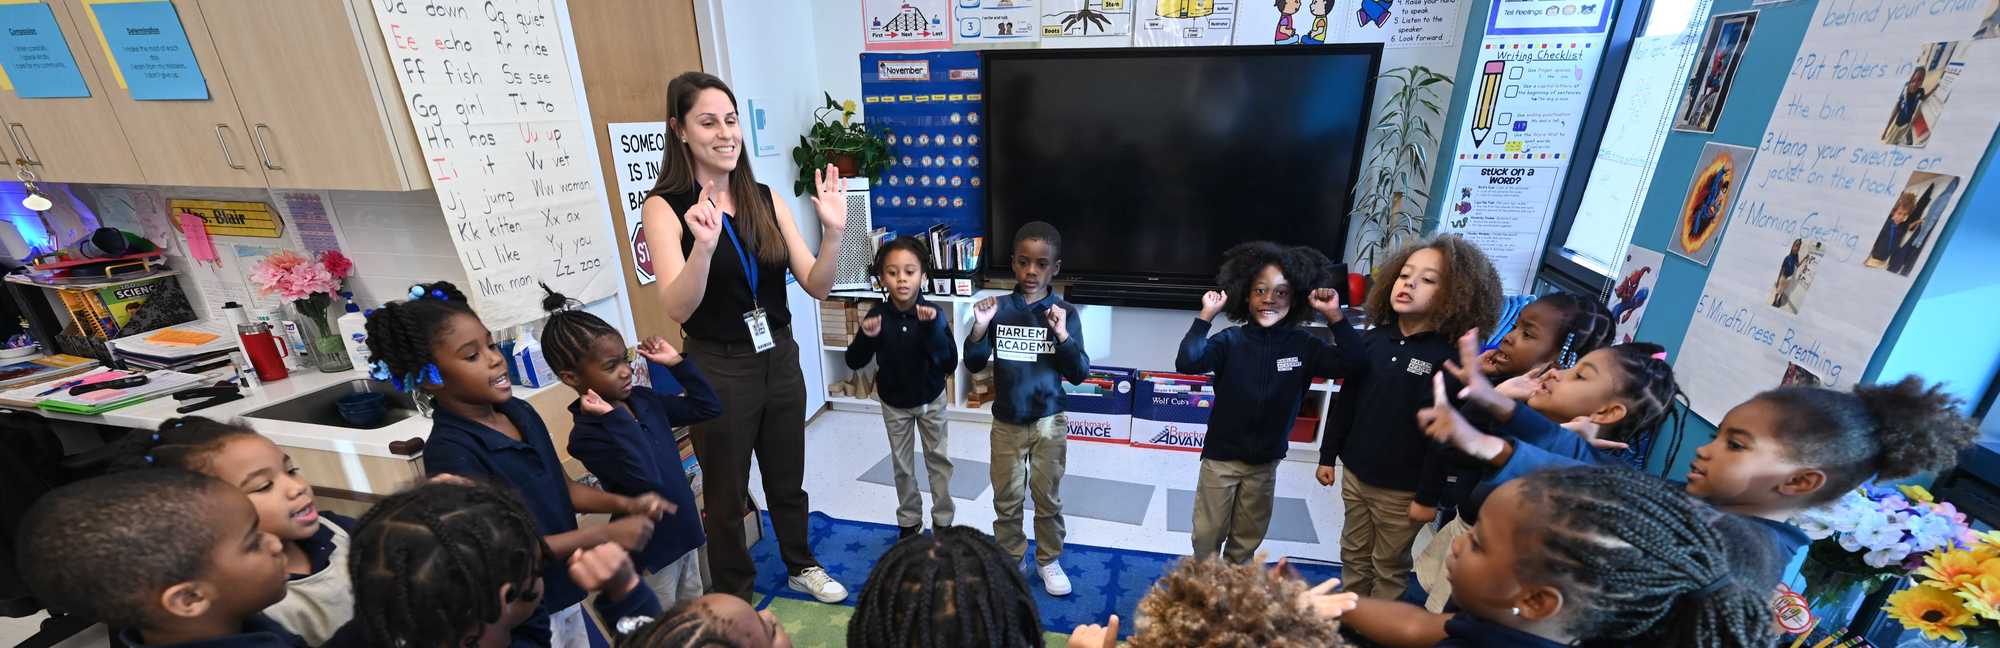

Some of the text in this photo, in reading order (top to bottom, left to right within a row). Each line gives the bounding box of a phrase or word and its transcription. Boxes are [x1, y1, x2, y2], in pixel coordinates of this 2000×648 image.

[517, 9, 545, 34] quiet
[968, 21, 974, 31] 3
[1401, 16, 1421, 24] Listen
[391, 24, 473, 51] Ee echo
[1416, 33, 1443, 41] forward
[1497, 49, 1583, 63] Writing Checklist
[1803, 53, 1826, 80] Put
[1833, 49, 1889, 80] folders
[403, 58, 483, 85] Ff fish
[502, 63, 551, 85] Ss see
[886, 66, 924, 75] November
[412, 93, 485, 127] Gg girl
[509, 92, 555, 114] Tt to
[1788, 93, 1810, 118] the
[424, 126, 455, 149] Hh
[519, 120, 562, 150] Uu up
[621, 133, 666, 154] SOMEO
[525, 149, 570, 170] Vv vet
[1773, 137, 1807, 162] Hang
[1811, 144, 1847, 169] your
[1916, 156, 1942, 170] or
[479, 154, 496, 176] it
[628, 161, 661, 182] IS IN
[1511, 168, 1525, 176] on
[1759, 162, 1805, 189] jacket
[1807, 170, 1824, 184] on
[1831, 167, 1855, 190] the
[532, 178, 555, 198] Ww
[1489, 177, 1522, 185] WORD?
[447, 187, 515, 220] Jj jump
[213, 208, 246, 225] Blair
[540, 208, 561, 229] Xx
[457, 216, 522, 242] Kk kitten
[1745, 201, 1798, 247] Morning
[1800, 212, 1860, 263] Greeting
[546, 233, 592, 258] Yy you
[466, 243, 521, 271] Ll like
[553, 258, 601, 278] Zz zoo
[477, 276, 505, 297] Mm
[997, 325, 1046, 339] HARLEM
[1705, 297, 1776, 346] Mindfulness
[1778, 328, 1843, 387] Breathing
[997, 339, 1054, 352] ACADEMY
[1152, 396, 1170, 405] Wolf
